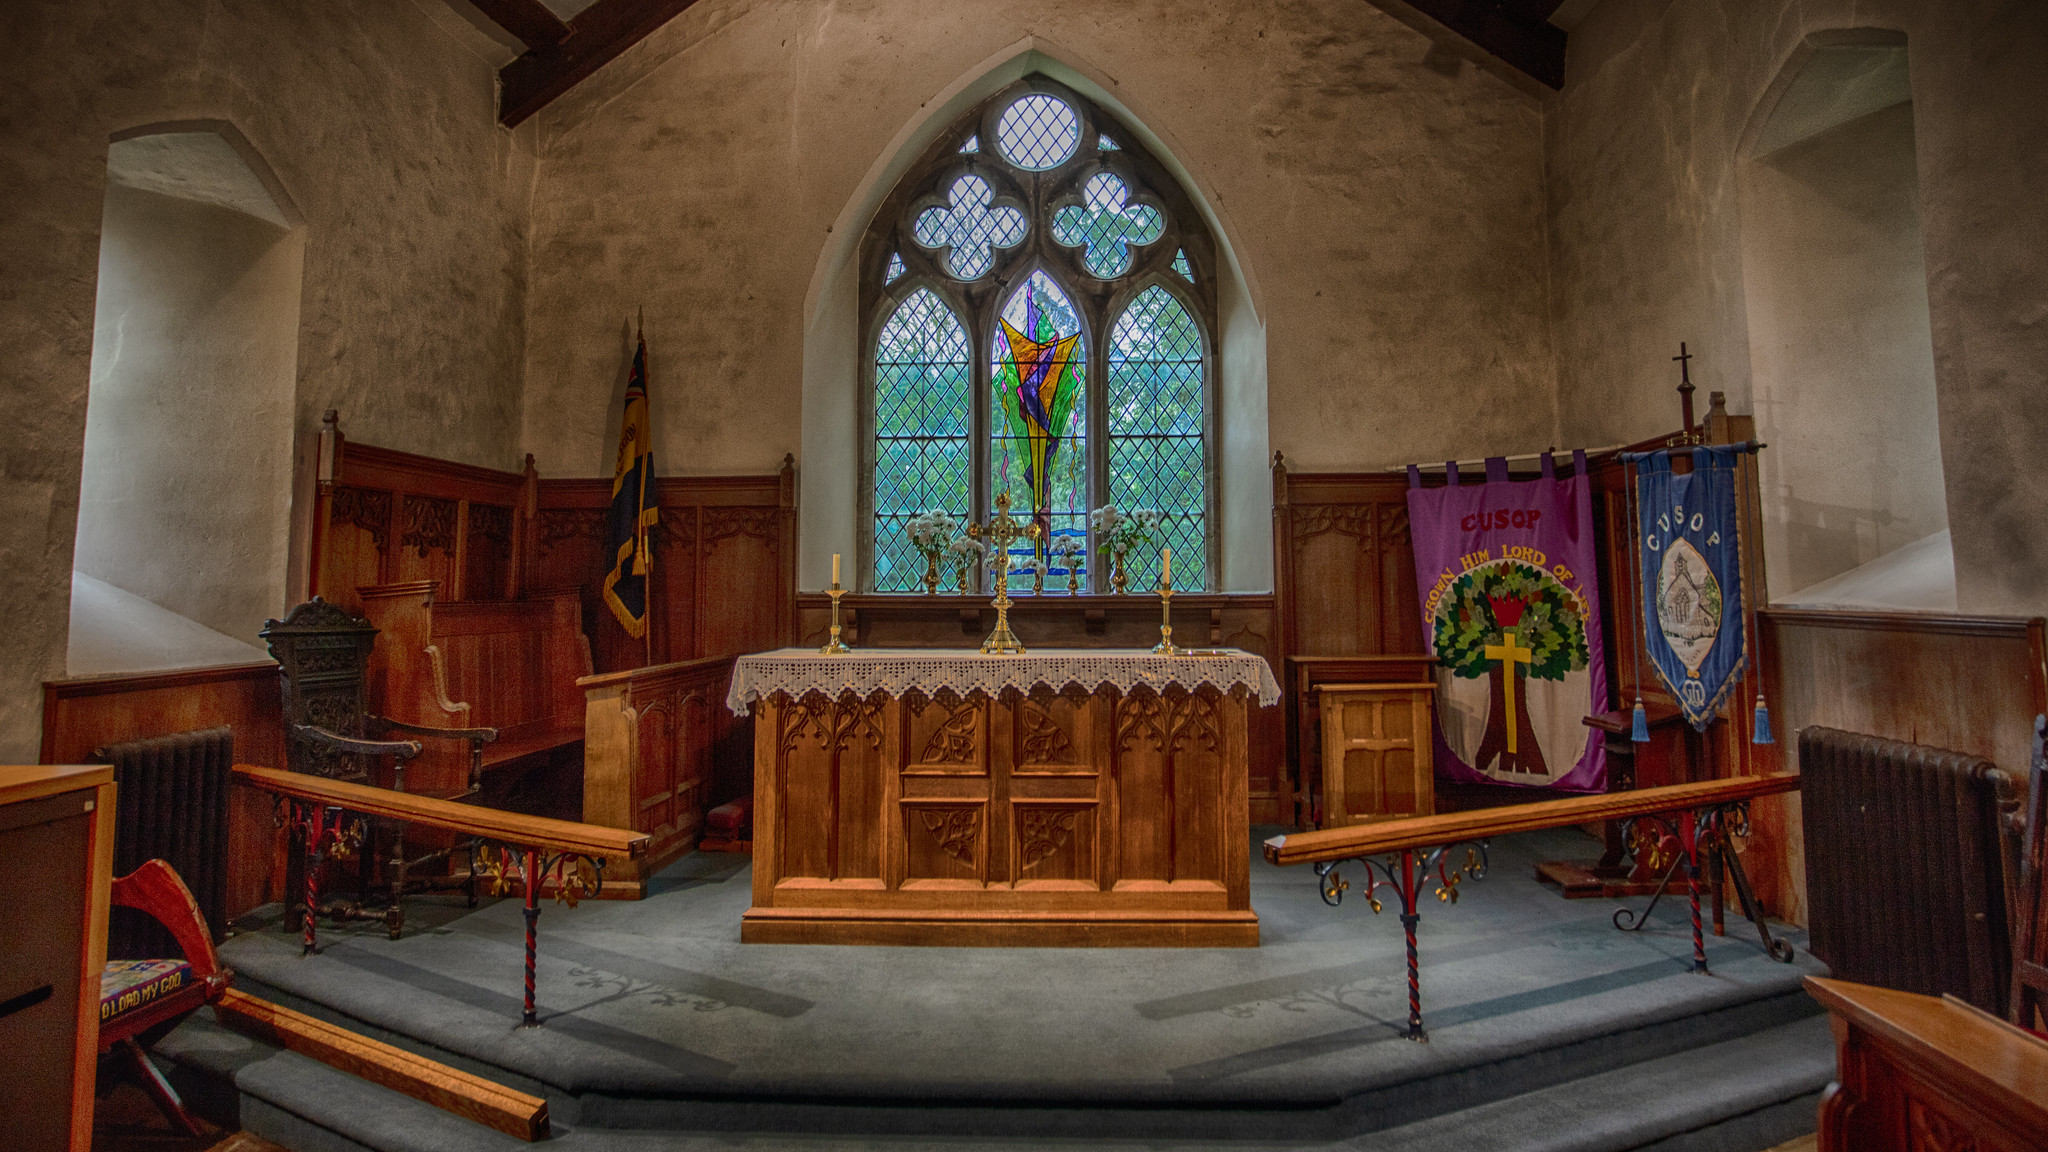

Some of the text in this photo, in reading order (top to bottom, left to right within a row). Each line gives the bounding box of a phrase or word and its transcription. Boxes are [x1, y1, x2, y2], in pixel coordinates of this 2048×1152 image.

[1461, 508, 1541, 532] CUSOP
[1647, 505, 1721, 551] CUSOP
[1424, 567, 1456, 624] CROWN
[1459, 548, 1490, 571] HIM
[1501, 544, 1546, 567] LORD
[1553, 564, 1574, 583] OF
[101, 971, 181, 1019] O LORD MY GOD
